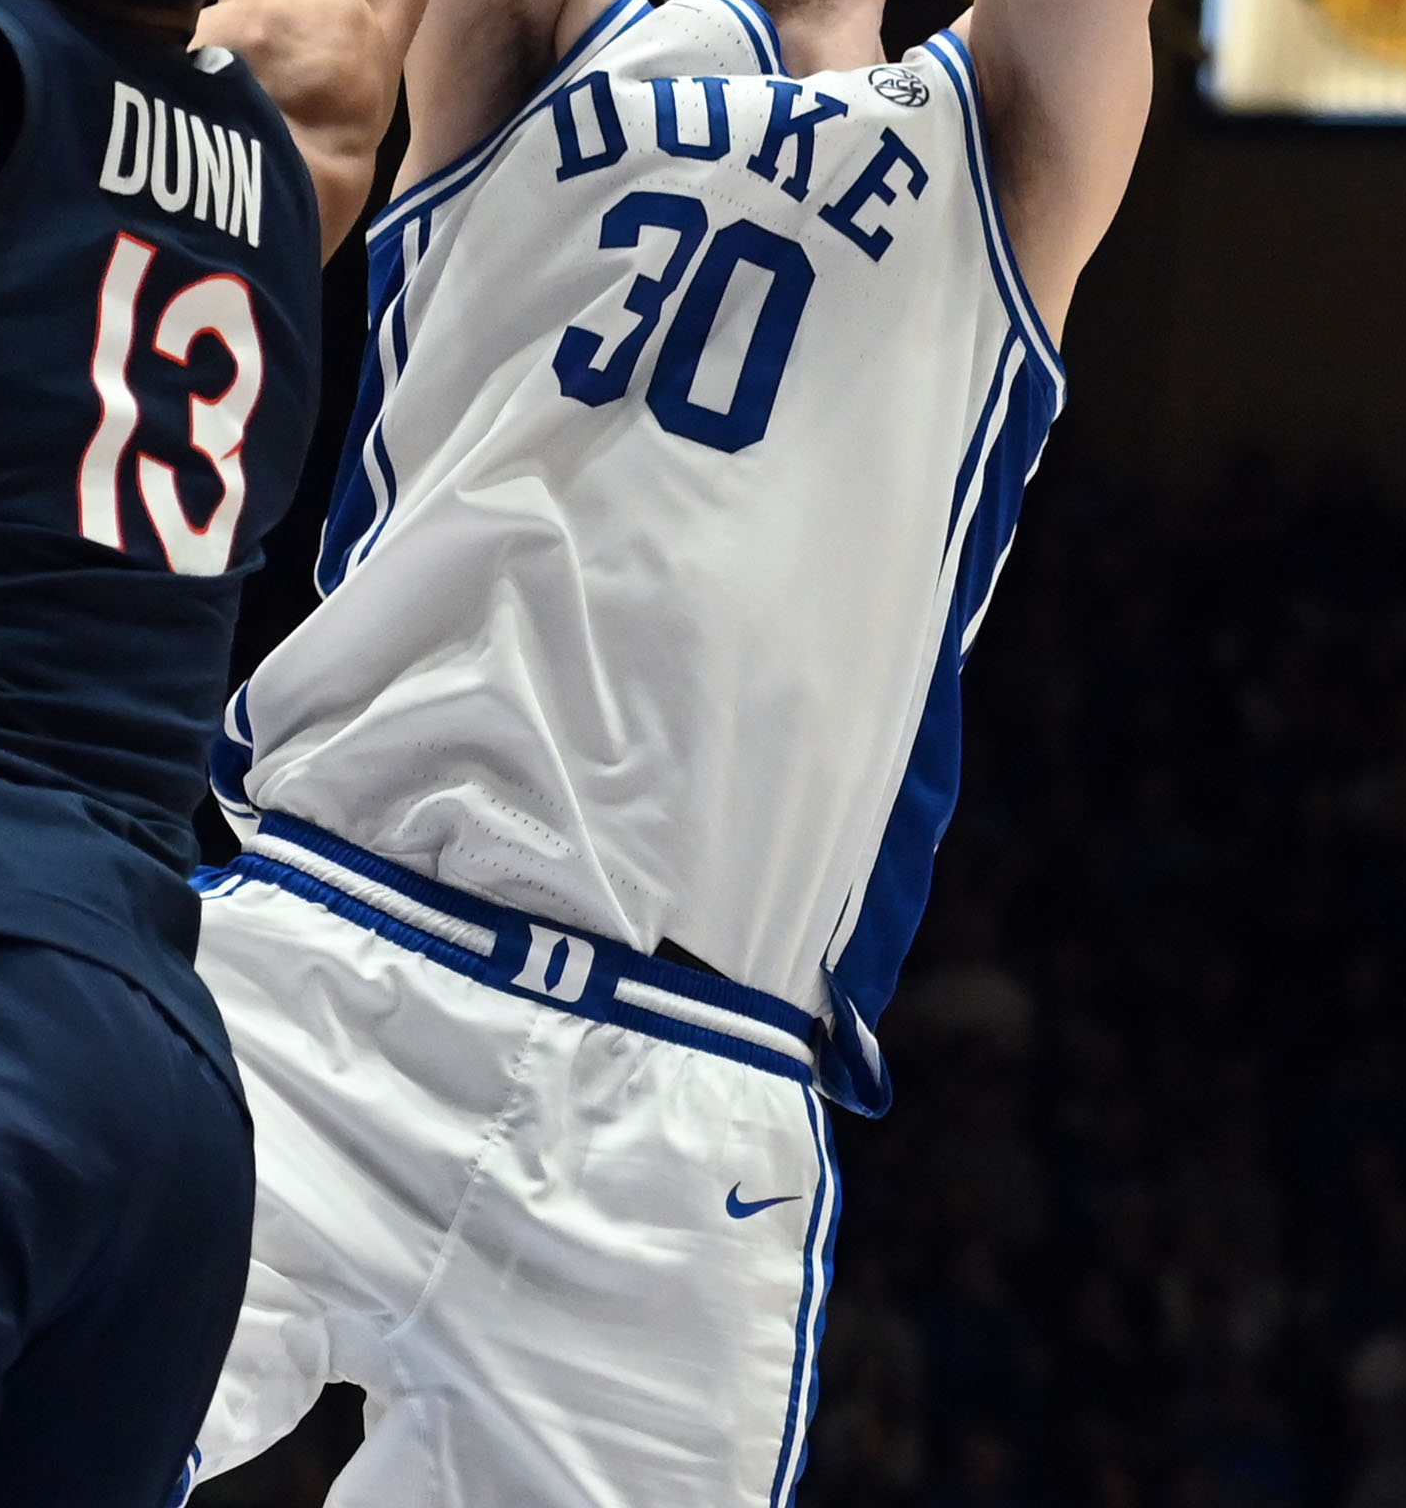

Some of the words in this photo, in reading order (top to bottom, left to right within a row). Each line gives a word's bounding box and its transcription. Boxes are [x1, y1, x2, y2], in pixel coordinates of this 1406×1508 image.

[99, 80, 262, 248] DUNN
[552, 70, 929, 263] DUKE
[77, 230, 265, 577] 13
[552, 191, 816, 454] 30
